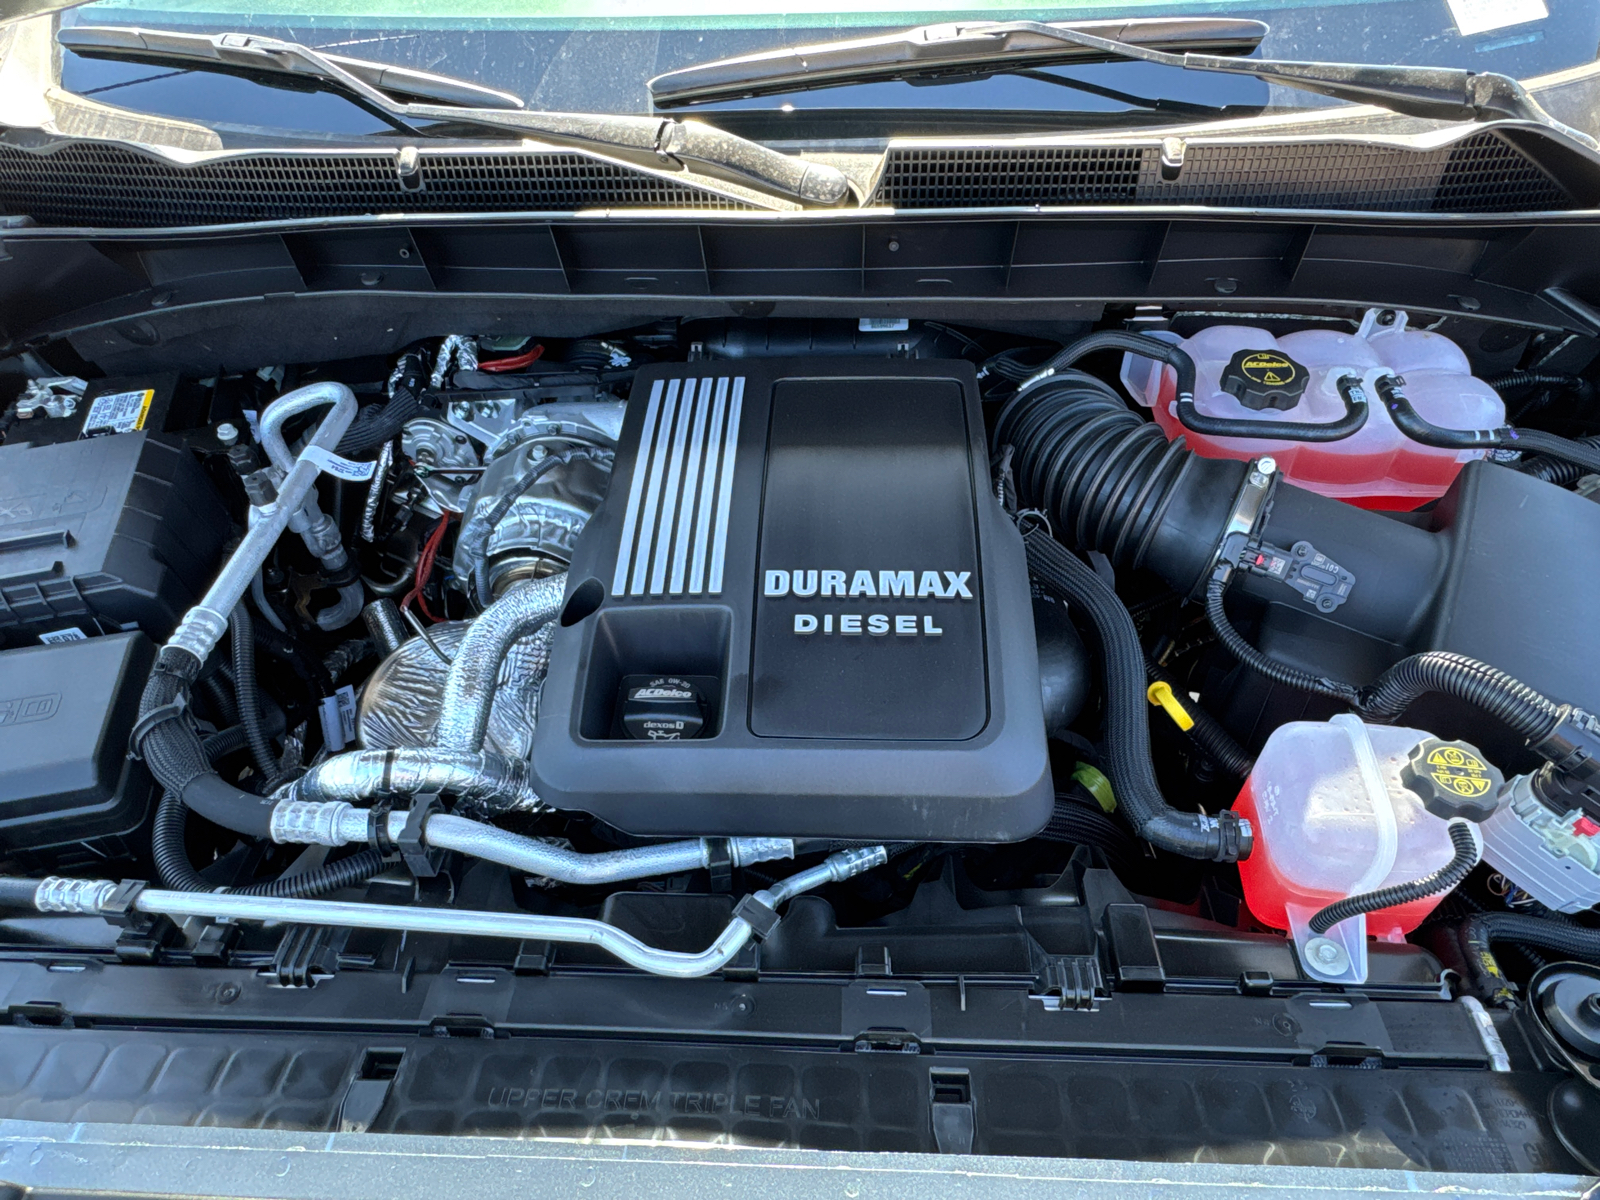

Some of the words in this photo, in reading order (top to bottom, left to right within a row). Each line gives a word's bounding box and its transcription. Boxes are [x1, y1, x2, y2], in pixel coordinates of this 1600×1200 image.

[764, 569, 973, 600] DURAMAX
[794, 614, 943, 637] DIESEL
[634, 688, 692, 699] ACDelco
[649, 678, 665, 688] SAE
[487, 1086, 578, 1109] UPPER
[669, 1091, 762, 1117] TRIPLE
[769, 1096, 820, 1120] FAN
